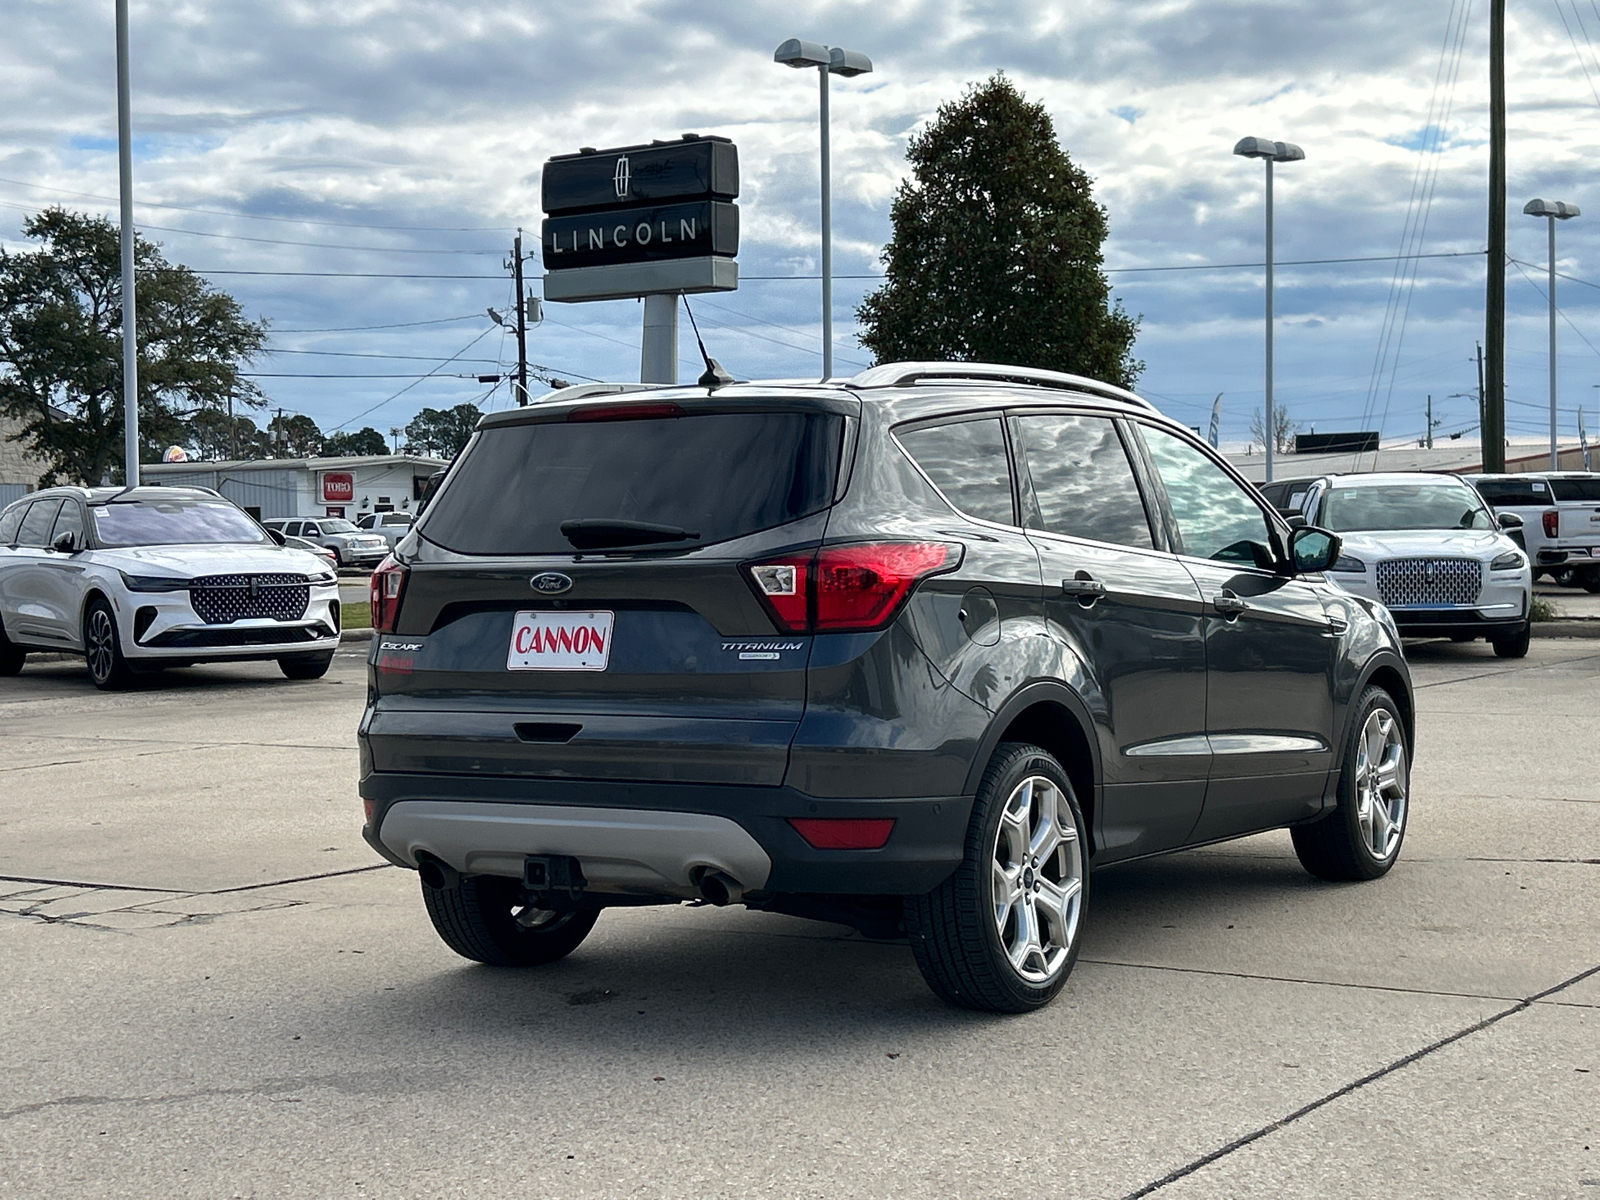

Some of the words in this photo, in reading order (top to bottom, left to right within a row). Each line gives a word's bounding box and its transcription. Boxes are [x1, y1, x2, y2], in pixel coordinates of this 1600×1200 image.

[552, 217, 697, 254] LINCOLN
[325, 481, 351, 493] TORO
[538, 575, 562, 590] Ford
[380, 641, 423, 651] ESCAPE
[515, 625, 607, 655] CANNON
[721, 642, 804, 651] TITANIUM
